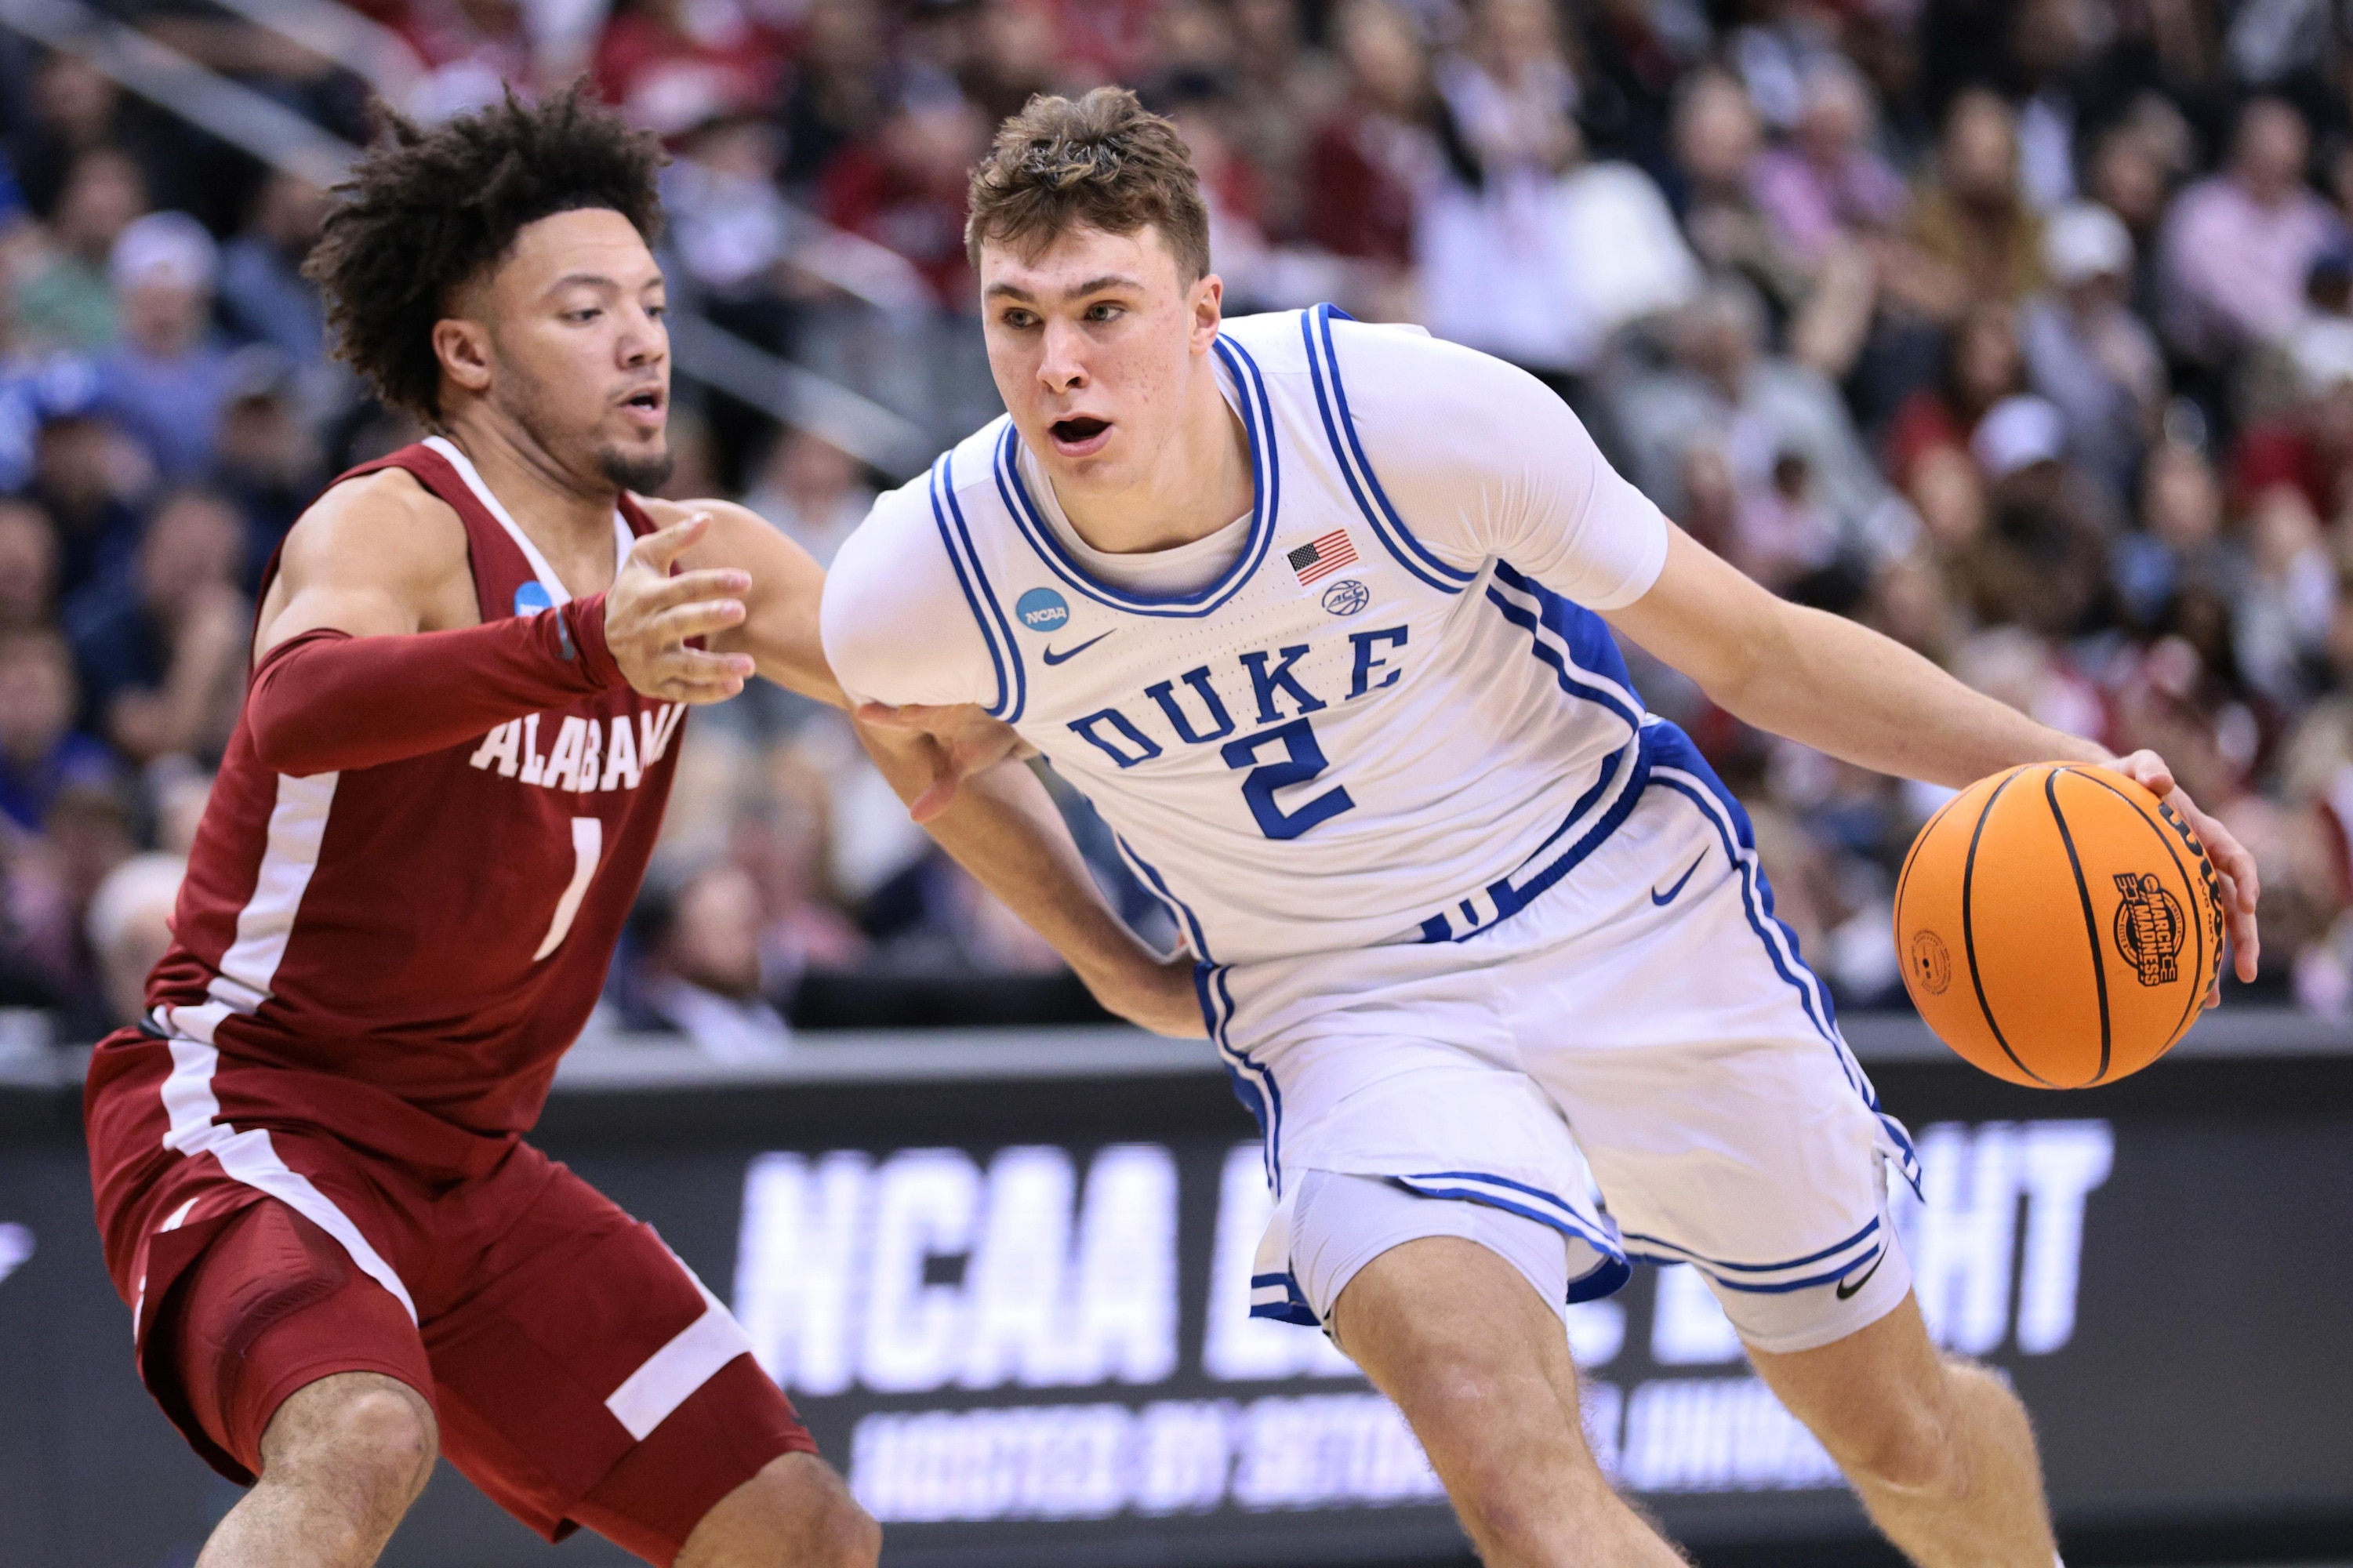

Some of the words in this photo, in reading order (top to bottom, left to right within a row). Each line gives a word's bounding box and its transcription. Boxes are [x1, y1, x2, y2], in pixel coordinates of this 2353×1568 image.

[1026, 607, 1067, 625] NCAA
[469, 702, 688, 793] ALABAM
[1066, 625, 1409, 768] DUKE
[1220, 717, 1356, 840] 2
[532, 817, 603, 962] 1
[2147, 892, 2173, 953] MARCH
[2133, 904, 2160, 986] MADNESS
[732, 1142, 1182, 1397] NCAA
